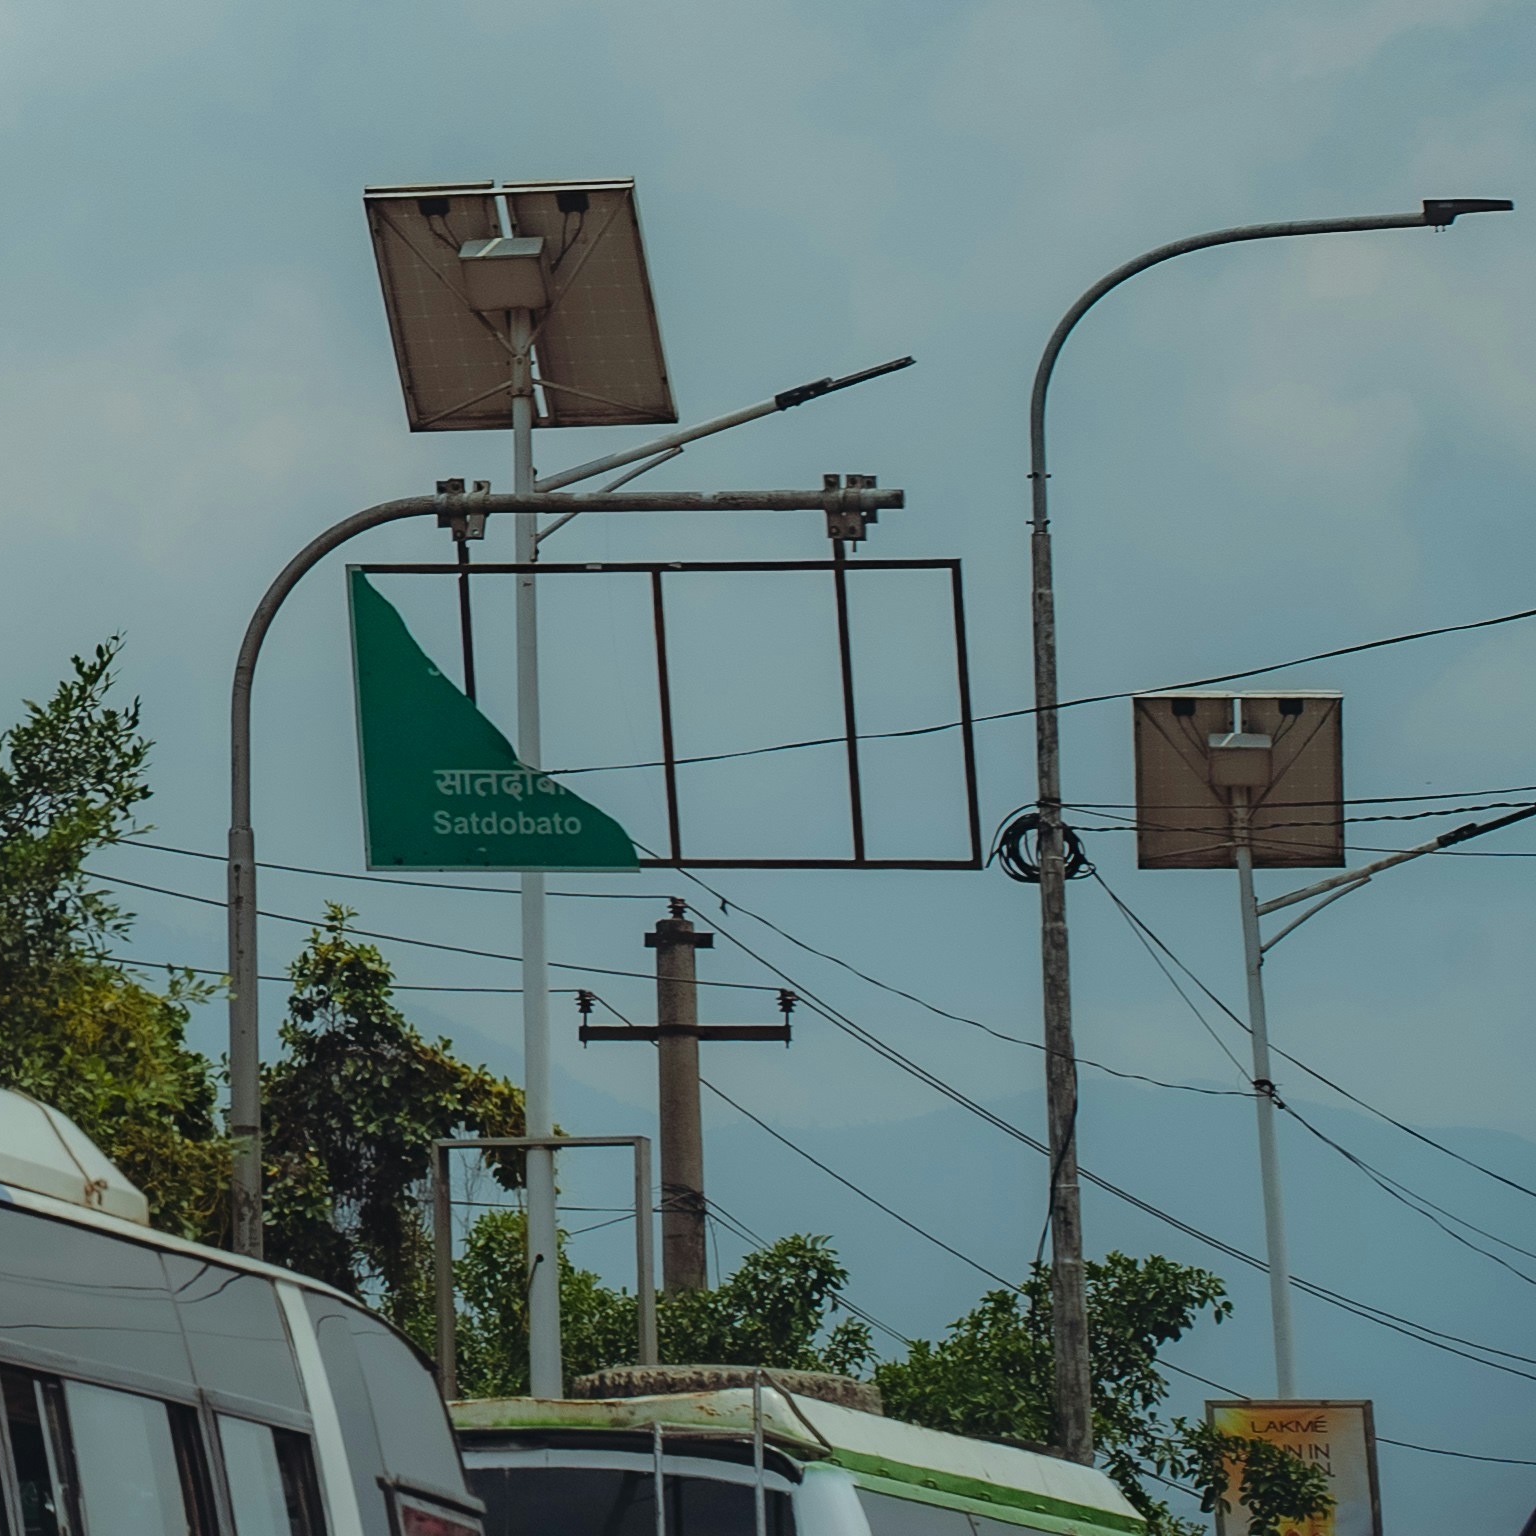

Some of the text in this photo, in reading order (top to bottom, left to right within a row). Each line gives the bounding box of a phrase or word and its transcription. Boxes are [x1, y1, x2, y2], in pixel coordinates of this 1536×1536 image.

[433, 810, 582, 835] Satdobato
[1251, 1415, 1328, 1434] LAKMÉ
[1308, 1443, 1330, 1460] IN
